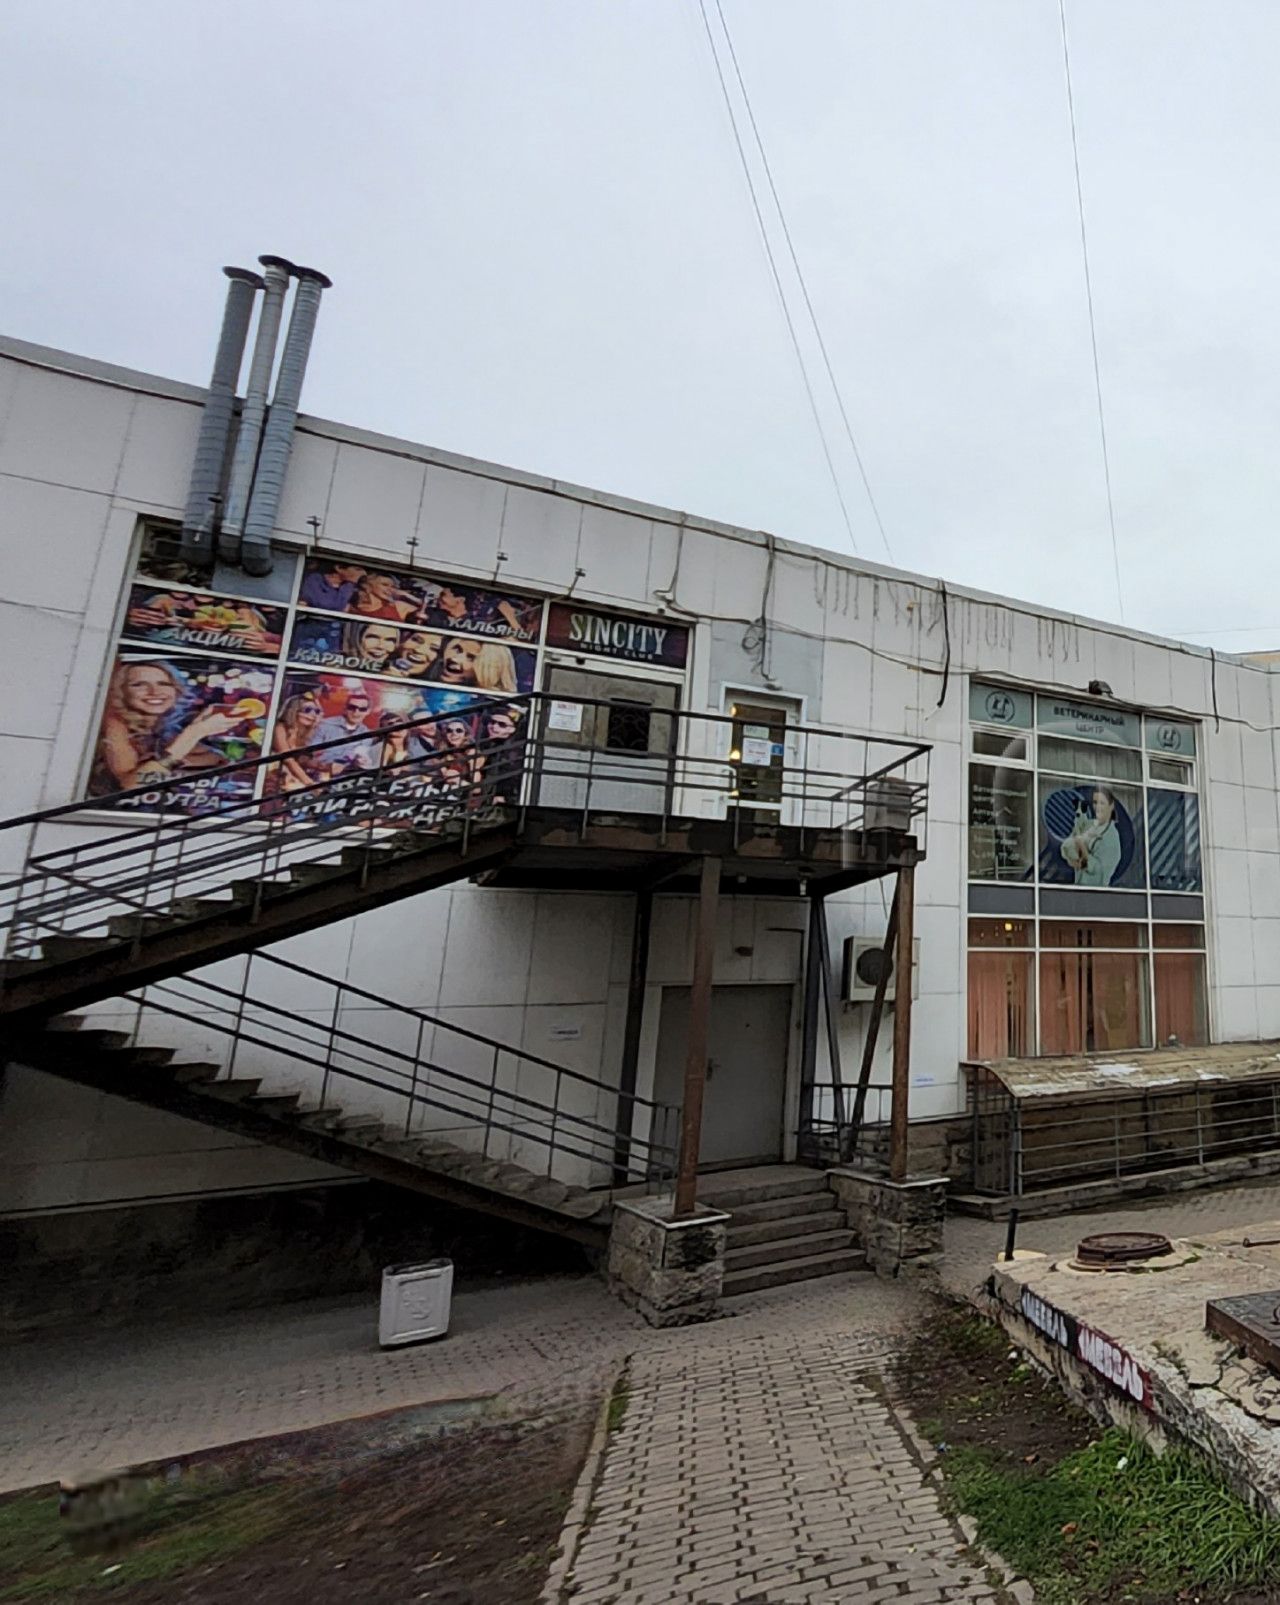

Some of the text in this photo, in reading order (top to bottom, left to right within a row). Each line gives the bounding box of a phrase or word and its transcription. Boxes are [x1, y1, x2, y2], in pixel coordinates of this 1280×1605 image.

[163, 627, 245, 649] АКЦИИ
[448, 617, 534, 640] КАЛЬЯНЫ
[569, 613, 668, 656] SINCITY
[293, 648, 385, 672] КАРАОКЕ
[163, 792, 220, 808] УТРА
